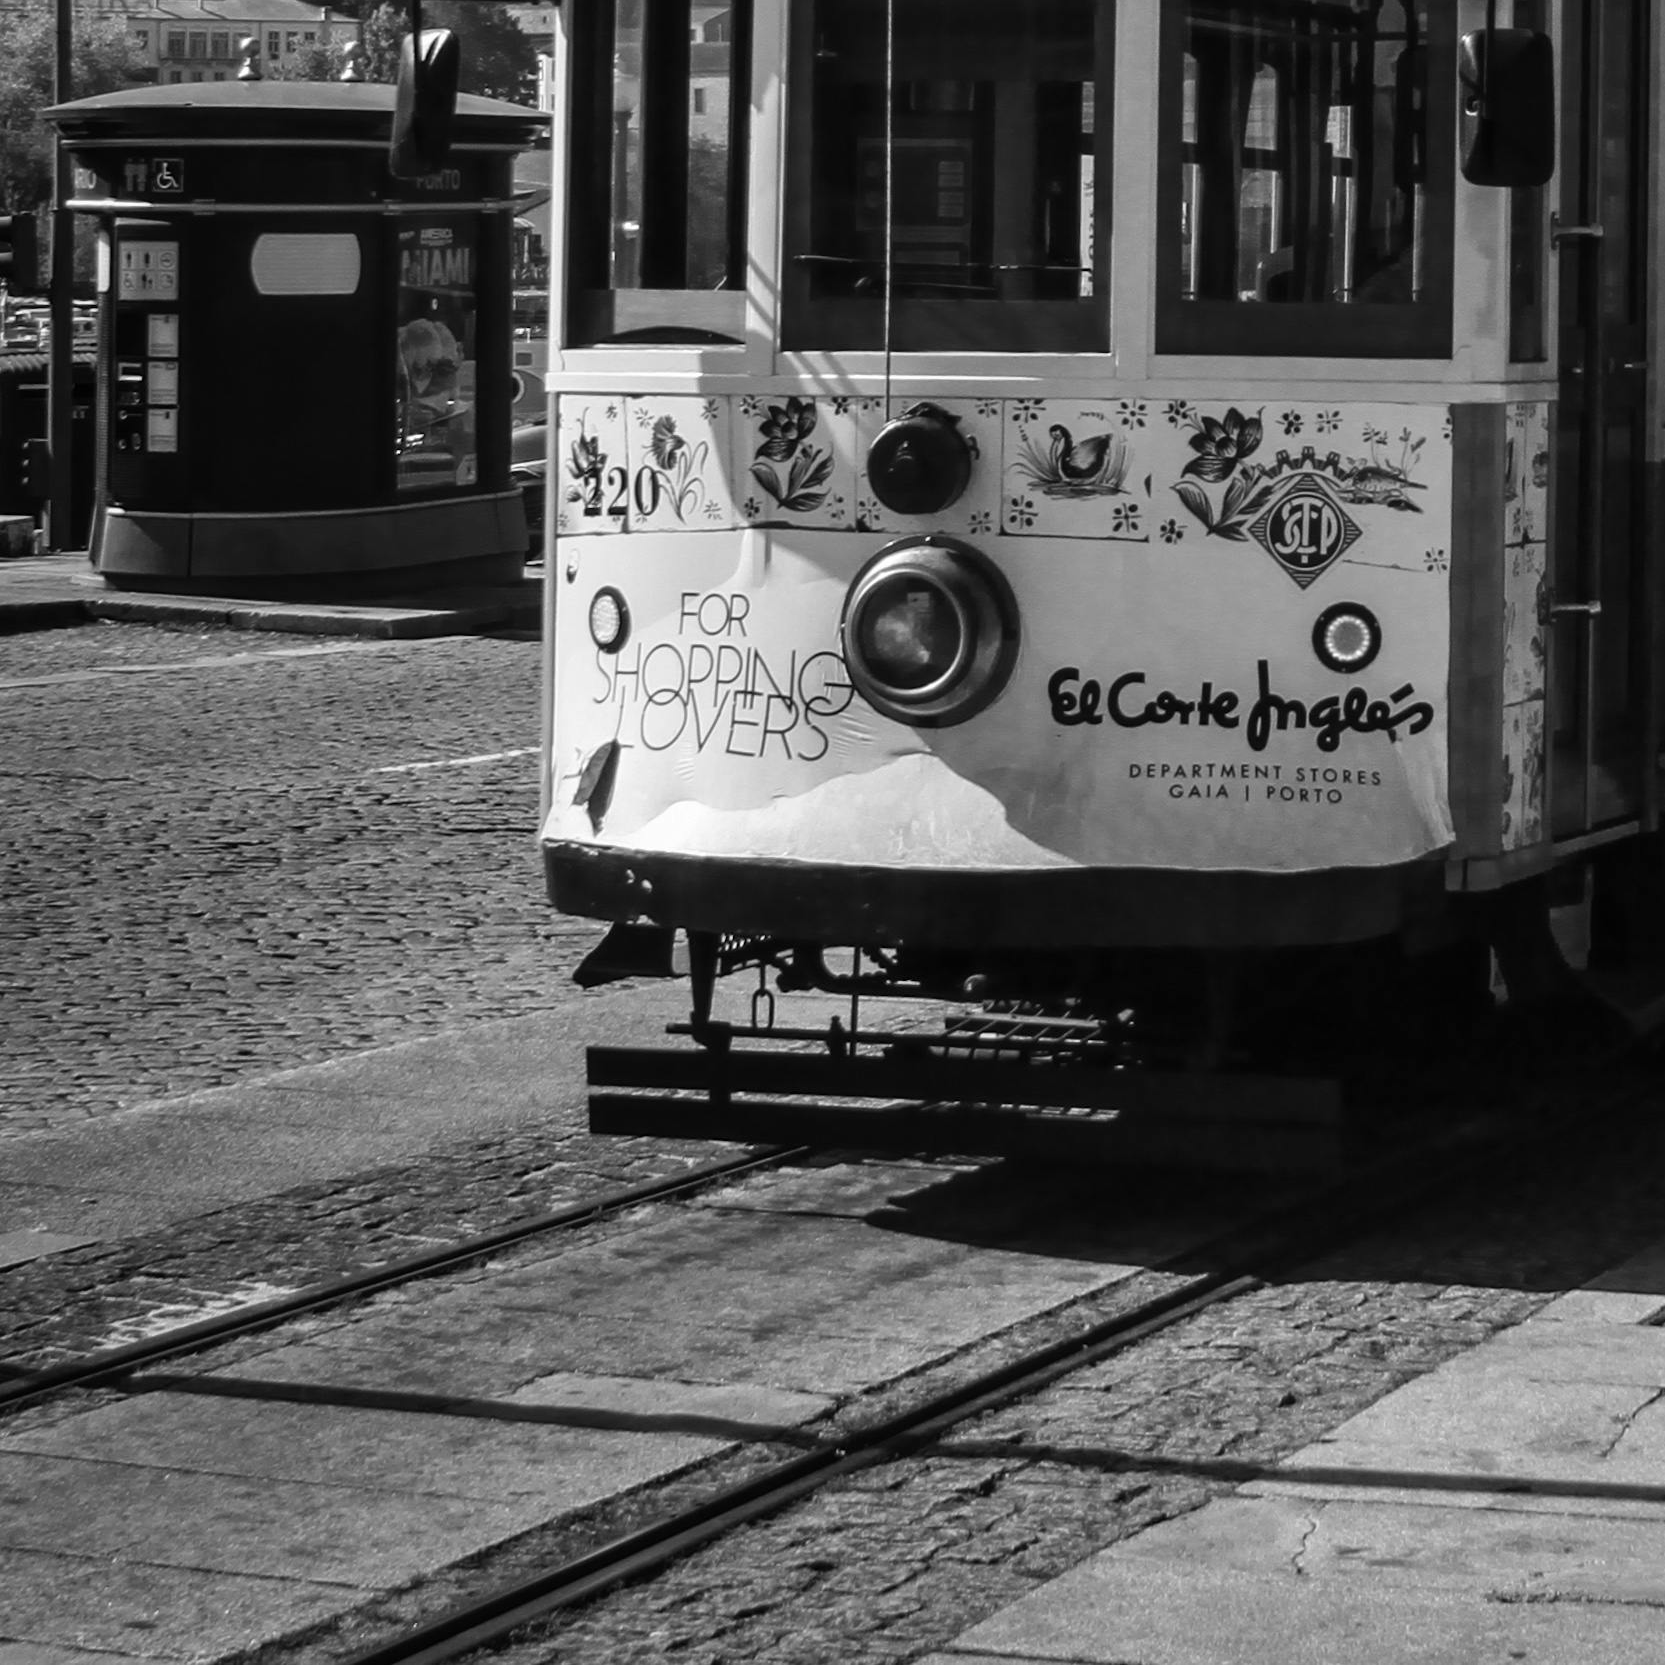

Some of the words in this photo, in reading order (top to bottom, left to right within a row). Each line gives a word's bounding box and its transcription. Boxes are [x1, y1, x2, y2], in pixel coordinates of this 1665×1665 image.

[583, 465, 661, 517] 220
[678, 592, 750, 637] FOR
[593, 642, 856, 716] SHOPPING
[1047, 667, 1102, 726] El
[1107, 672, 1240, 729] Corte
[1129, 763, 1282, 782] DEPARTMENT
[1296, 767, 1382, 787] STORES
[1169, 783, 1230, 800] GAIA
[1266, 785, 1343, 805] PORTO
